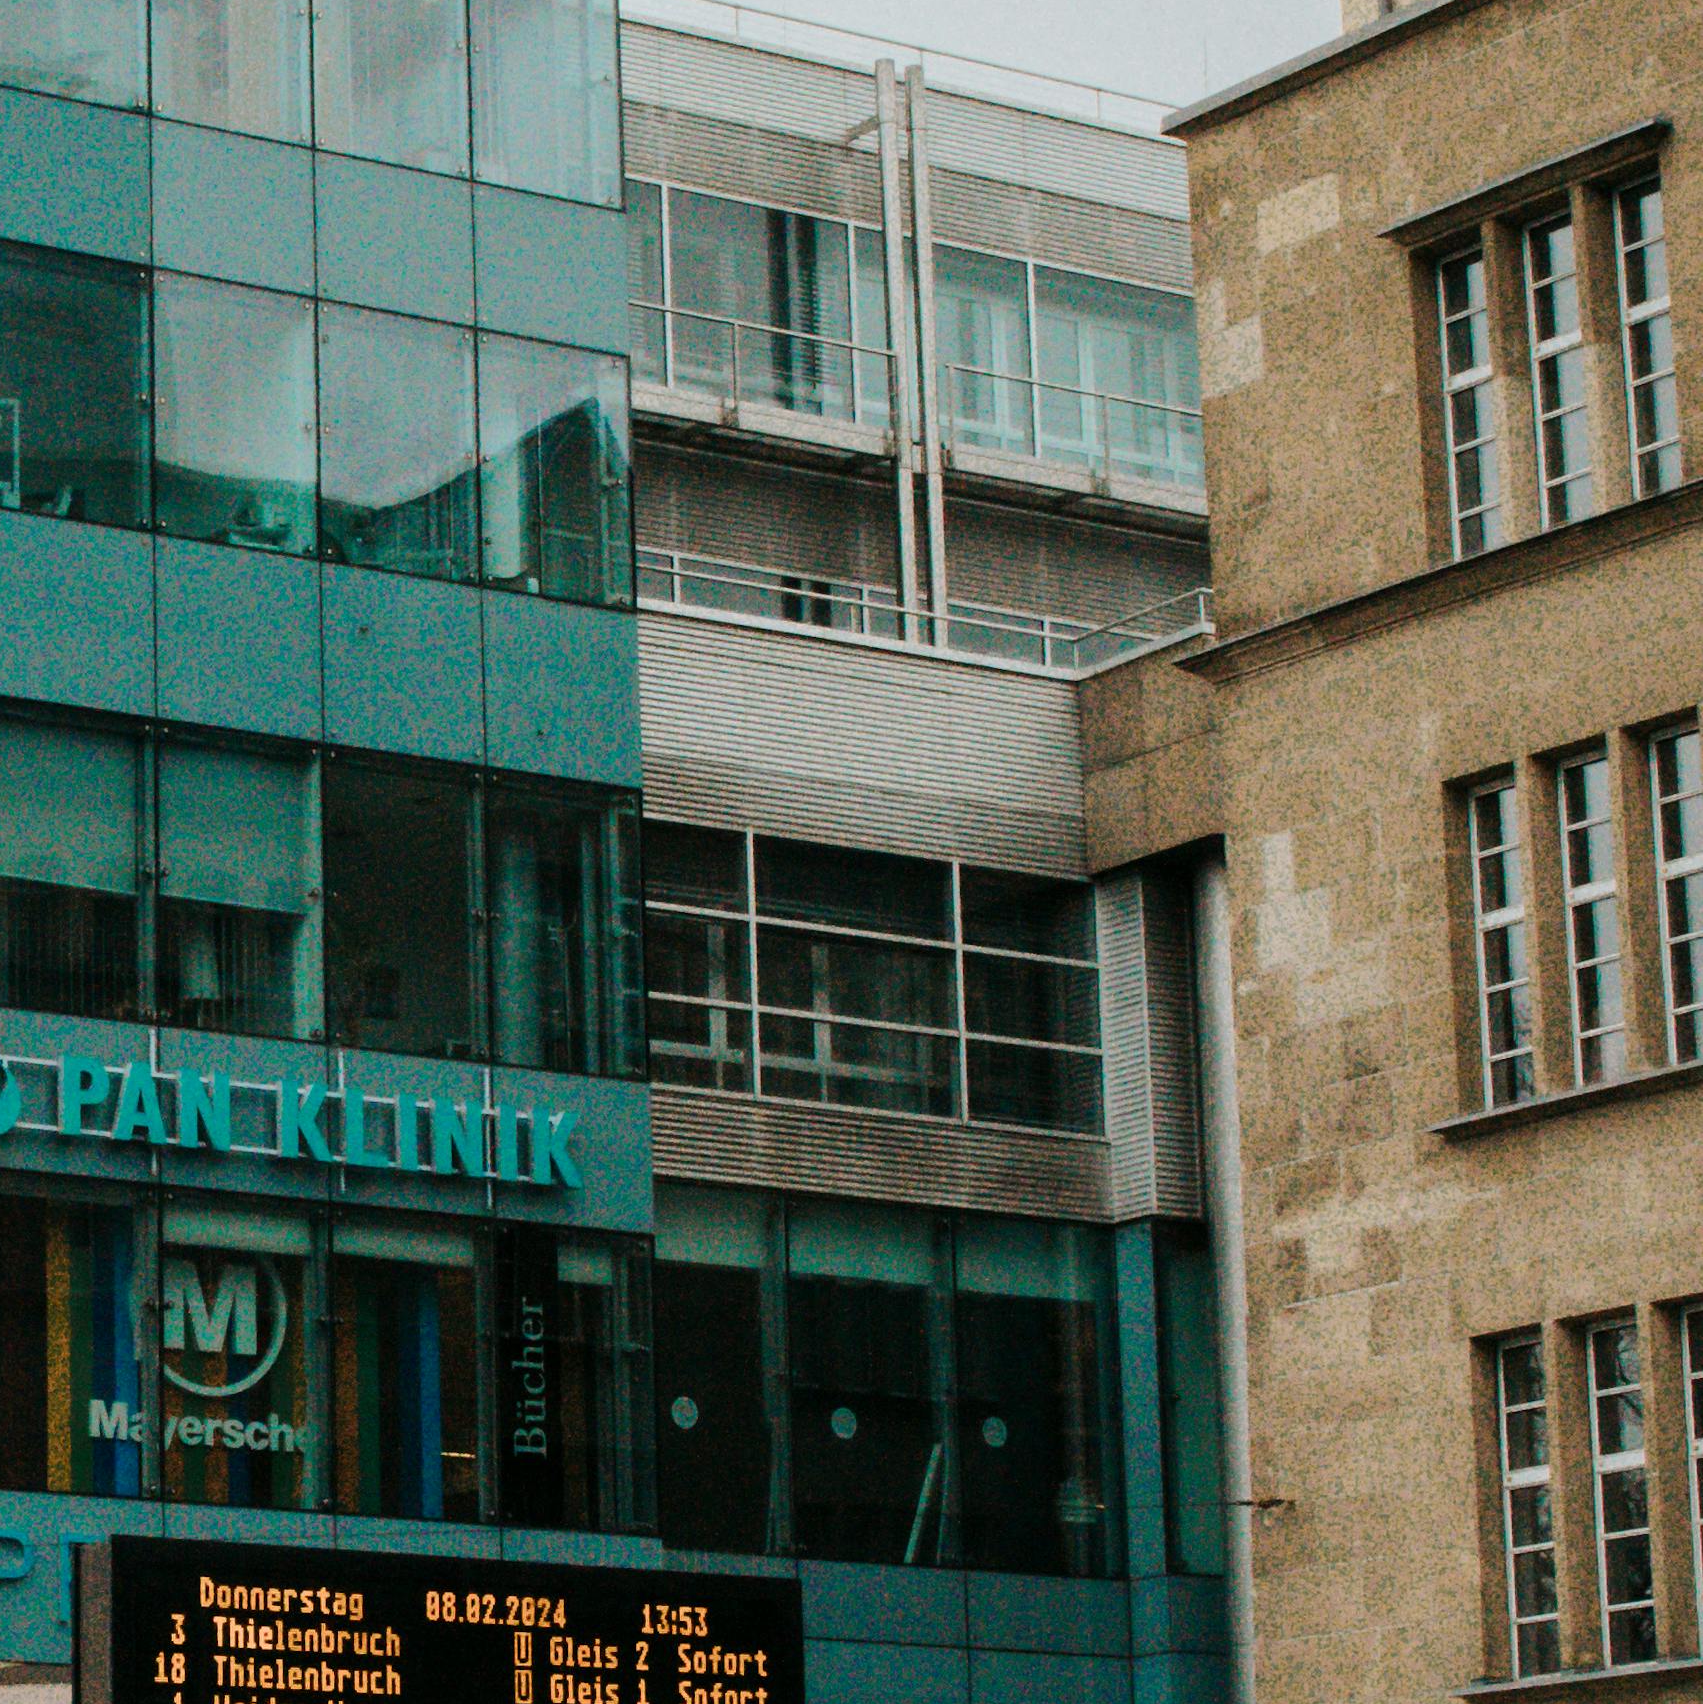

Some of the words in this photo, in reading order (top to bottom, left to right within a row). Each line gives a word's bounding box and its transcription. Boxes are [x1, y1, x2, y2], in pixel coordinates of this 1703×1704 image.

[59, 1055, 230, 1151] PAN
[277, 1079, 582, 1189] KLINIK
[511, 1297, 547, 1458] Bücher
[200, 1577, 363, 1621] Donnerstag
[427, 1591, 566, 1628] 08.02.2024
[642, 1604, 707, 1636] 13:53
[155, 1653, 185, 1683] 18
[214, 1654, 400, 1696] Thielenbruch
[172, 1614, 185, 1644] 3
[213, 1615, 400, 1659] Thielenbruch
[550, 1637, 618, 1668] Gleis
[636, 1641, 648, 1670] 2
[678, 1645, 767, 1676] Sofort
